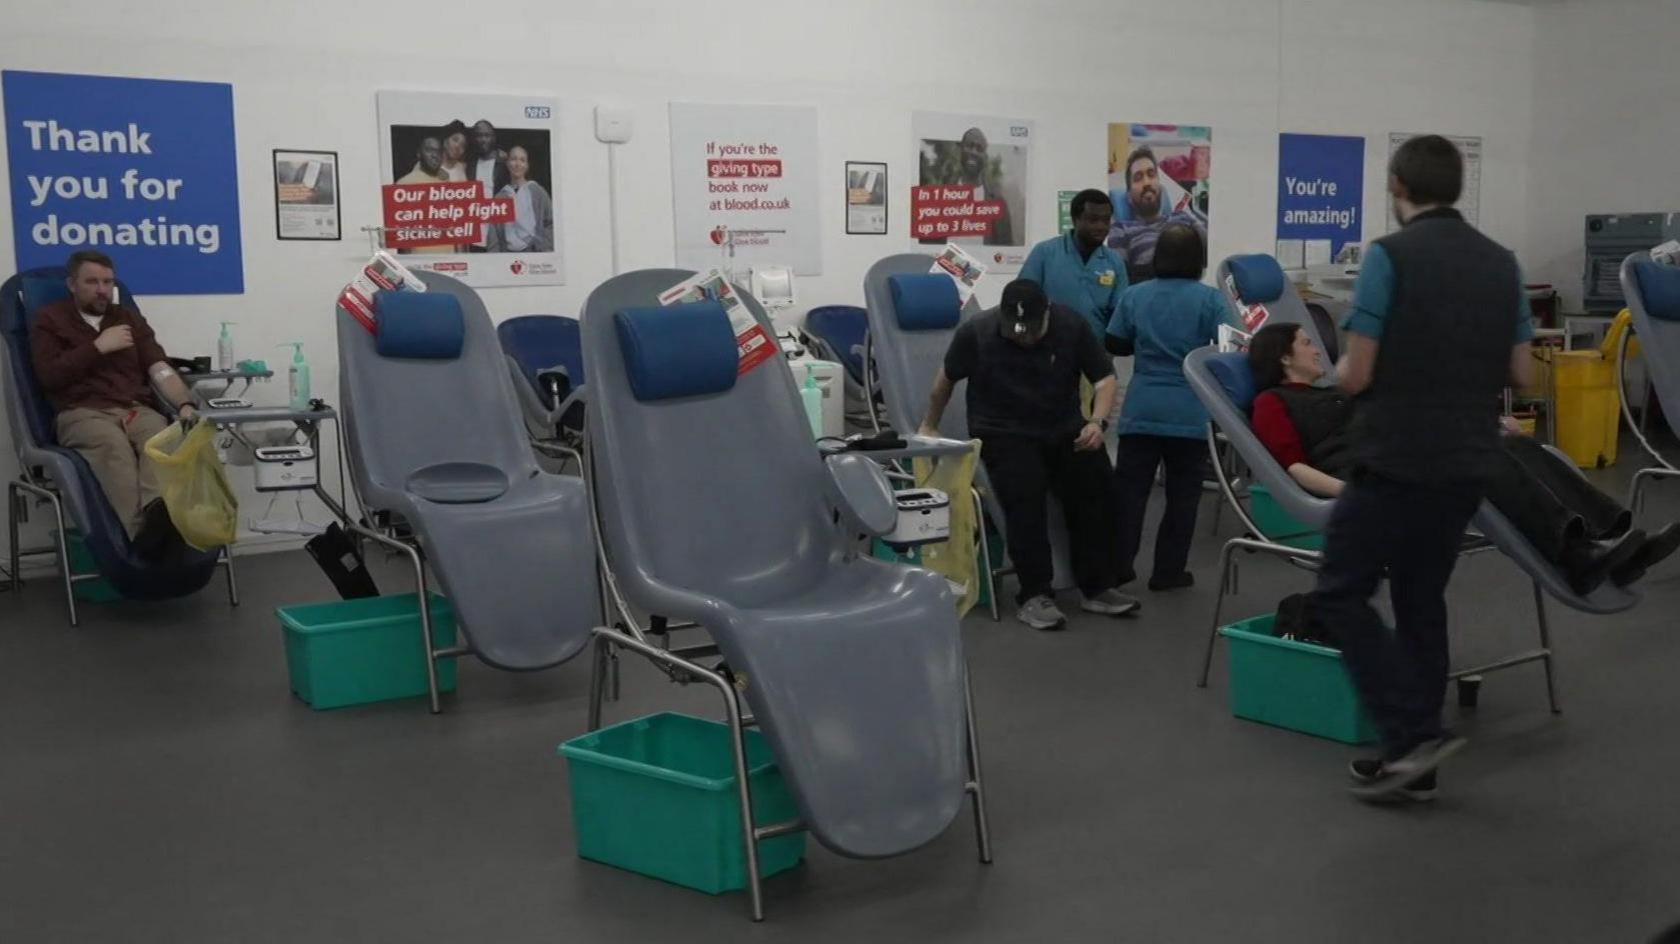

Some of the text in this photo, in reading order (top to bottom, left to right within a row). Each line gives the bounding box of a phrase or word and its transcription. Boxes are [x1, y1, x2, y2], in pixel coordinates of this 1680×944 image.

[524, 106, 550, 118] NHS
[23, 119, 152, 154] Thank
[706, 142, 778, 156] If you're the
[711, 162, 778, 177] giving type
[27, 168, 183, 207] you for
[708, 181, 769, 193] book now
[1286, 176, 1337, 196] You're
[393, 185, 477, 203] Our blood
[918, 188, 970, 200] In 1 hour
[709, 197, 791, 210] at blood.co.uk
[394, 202, 508, 221] can help fight
[918, 204, 1000, 219] you could save
[1284, 205, 1355, 229] amazing!
[32, 214, 220, 254] donating
[446, 222, 473, 237] cell
[918, 219, 986, 235] up to 3 lives
